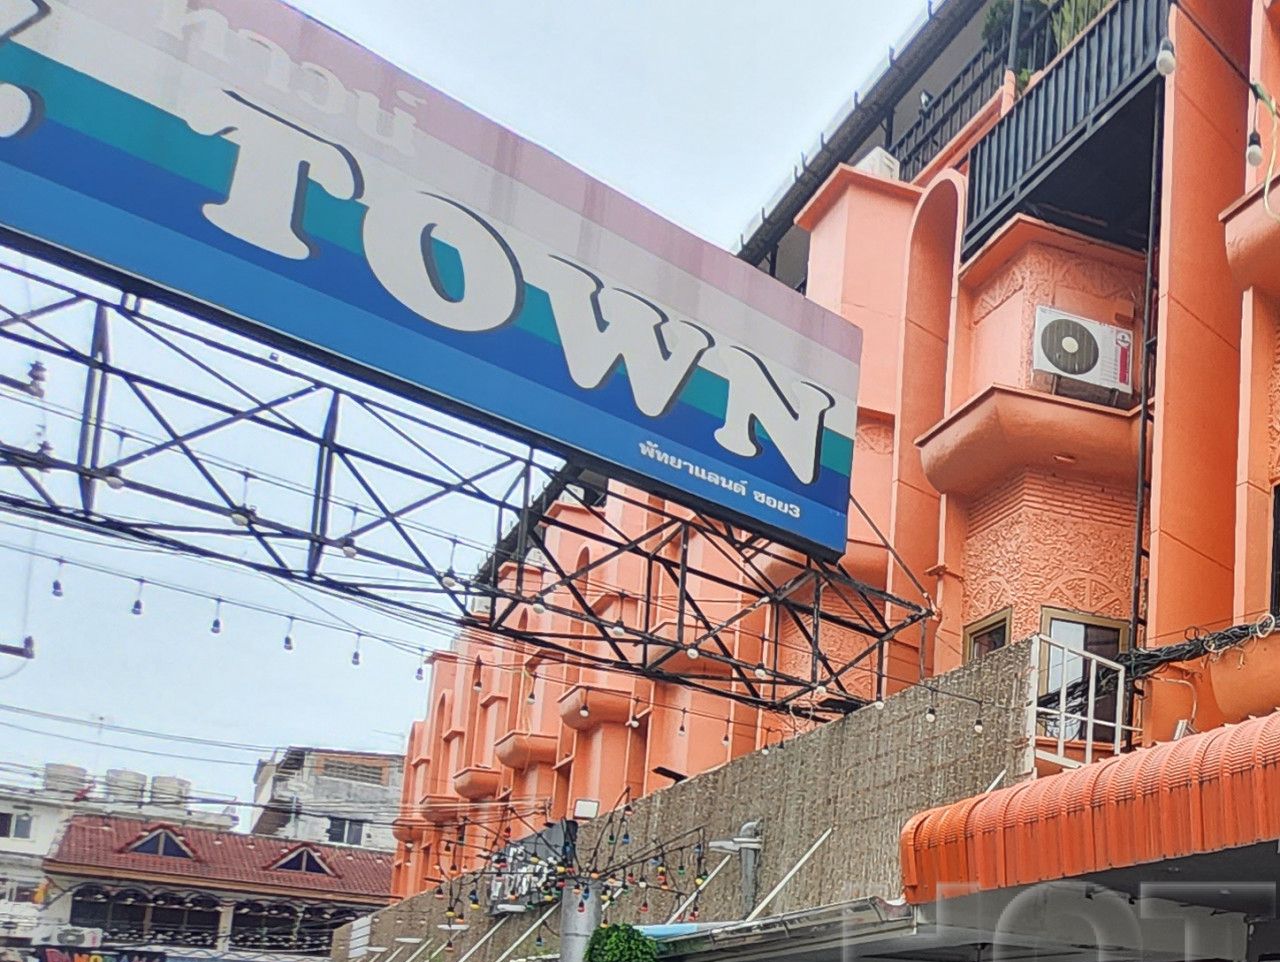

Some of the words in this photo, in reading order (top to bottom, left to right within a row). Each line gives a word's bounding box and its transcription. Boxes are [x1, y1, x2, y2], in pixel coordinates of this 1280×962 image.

[184, 90, 836, 486] TOWN
[638, 440, 748, 496] พัทยาแลนด์
[752, 490, 800, 518] ซอย3
